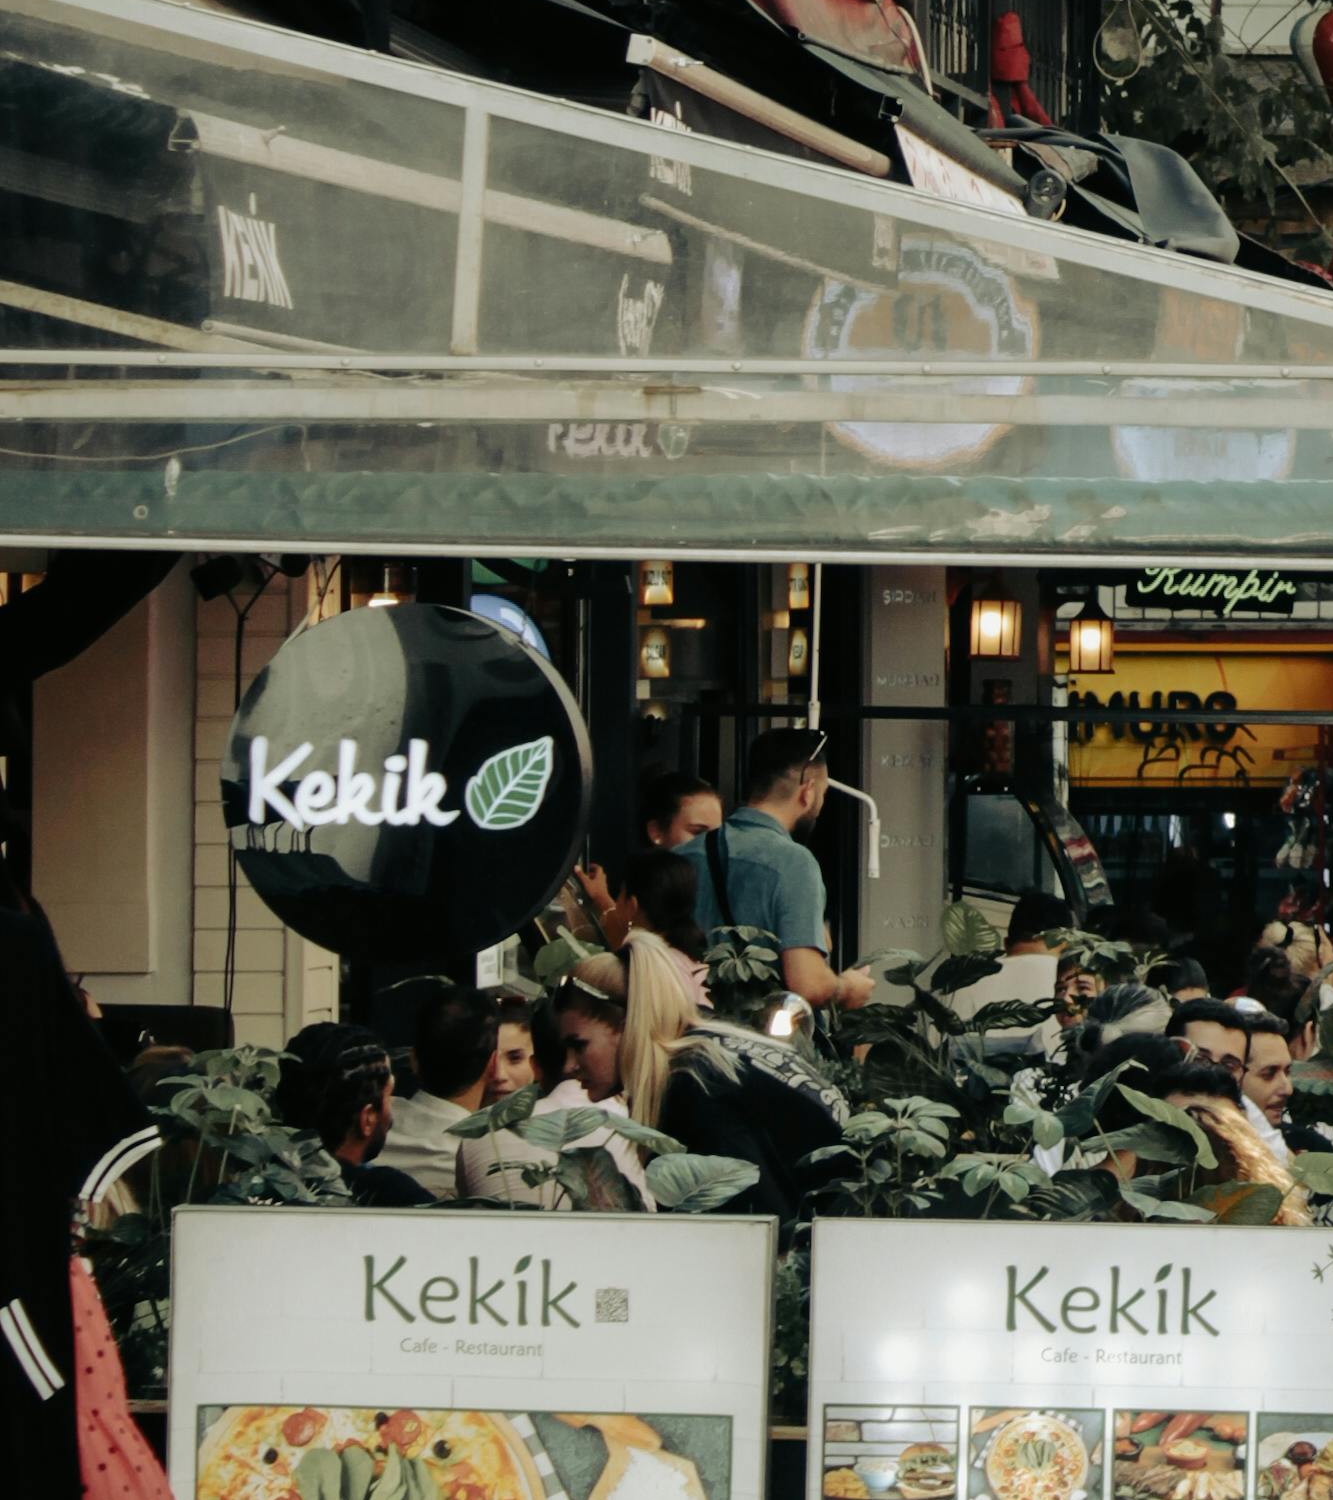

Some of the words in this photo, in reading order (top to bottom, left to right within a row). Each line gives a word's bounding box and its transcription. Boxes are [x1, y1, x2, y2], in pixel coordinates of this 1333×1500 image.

[249, 735, 461, 832] Kekik
[363, 1254, 581, 1329] Kekik
[1006, 1262, 1220, 1337] Kekik
[399, 1336, 438, 1354] Cafe
[455, 1339, 543, 1358] Restaurant
[1040, 1347, 1079, 1364] Cafe
[1095, 1348, 1183, 1366] Restaurant
